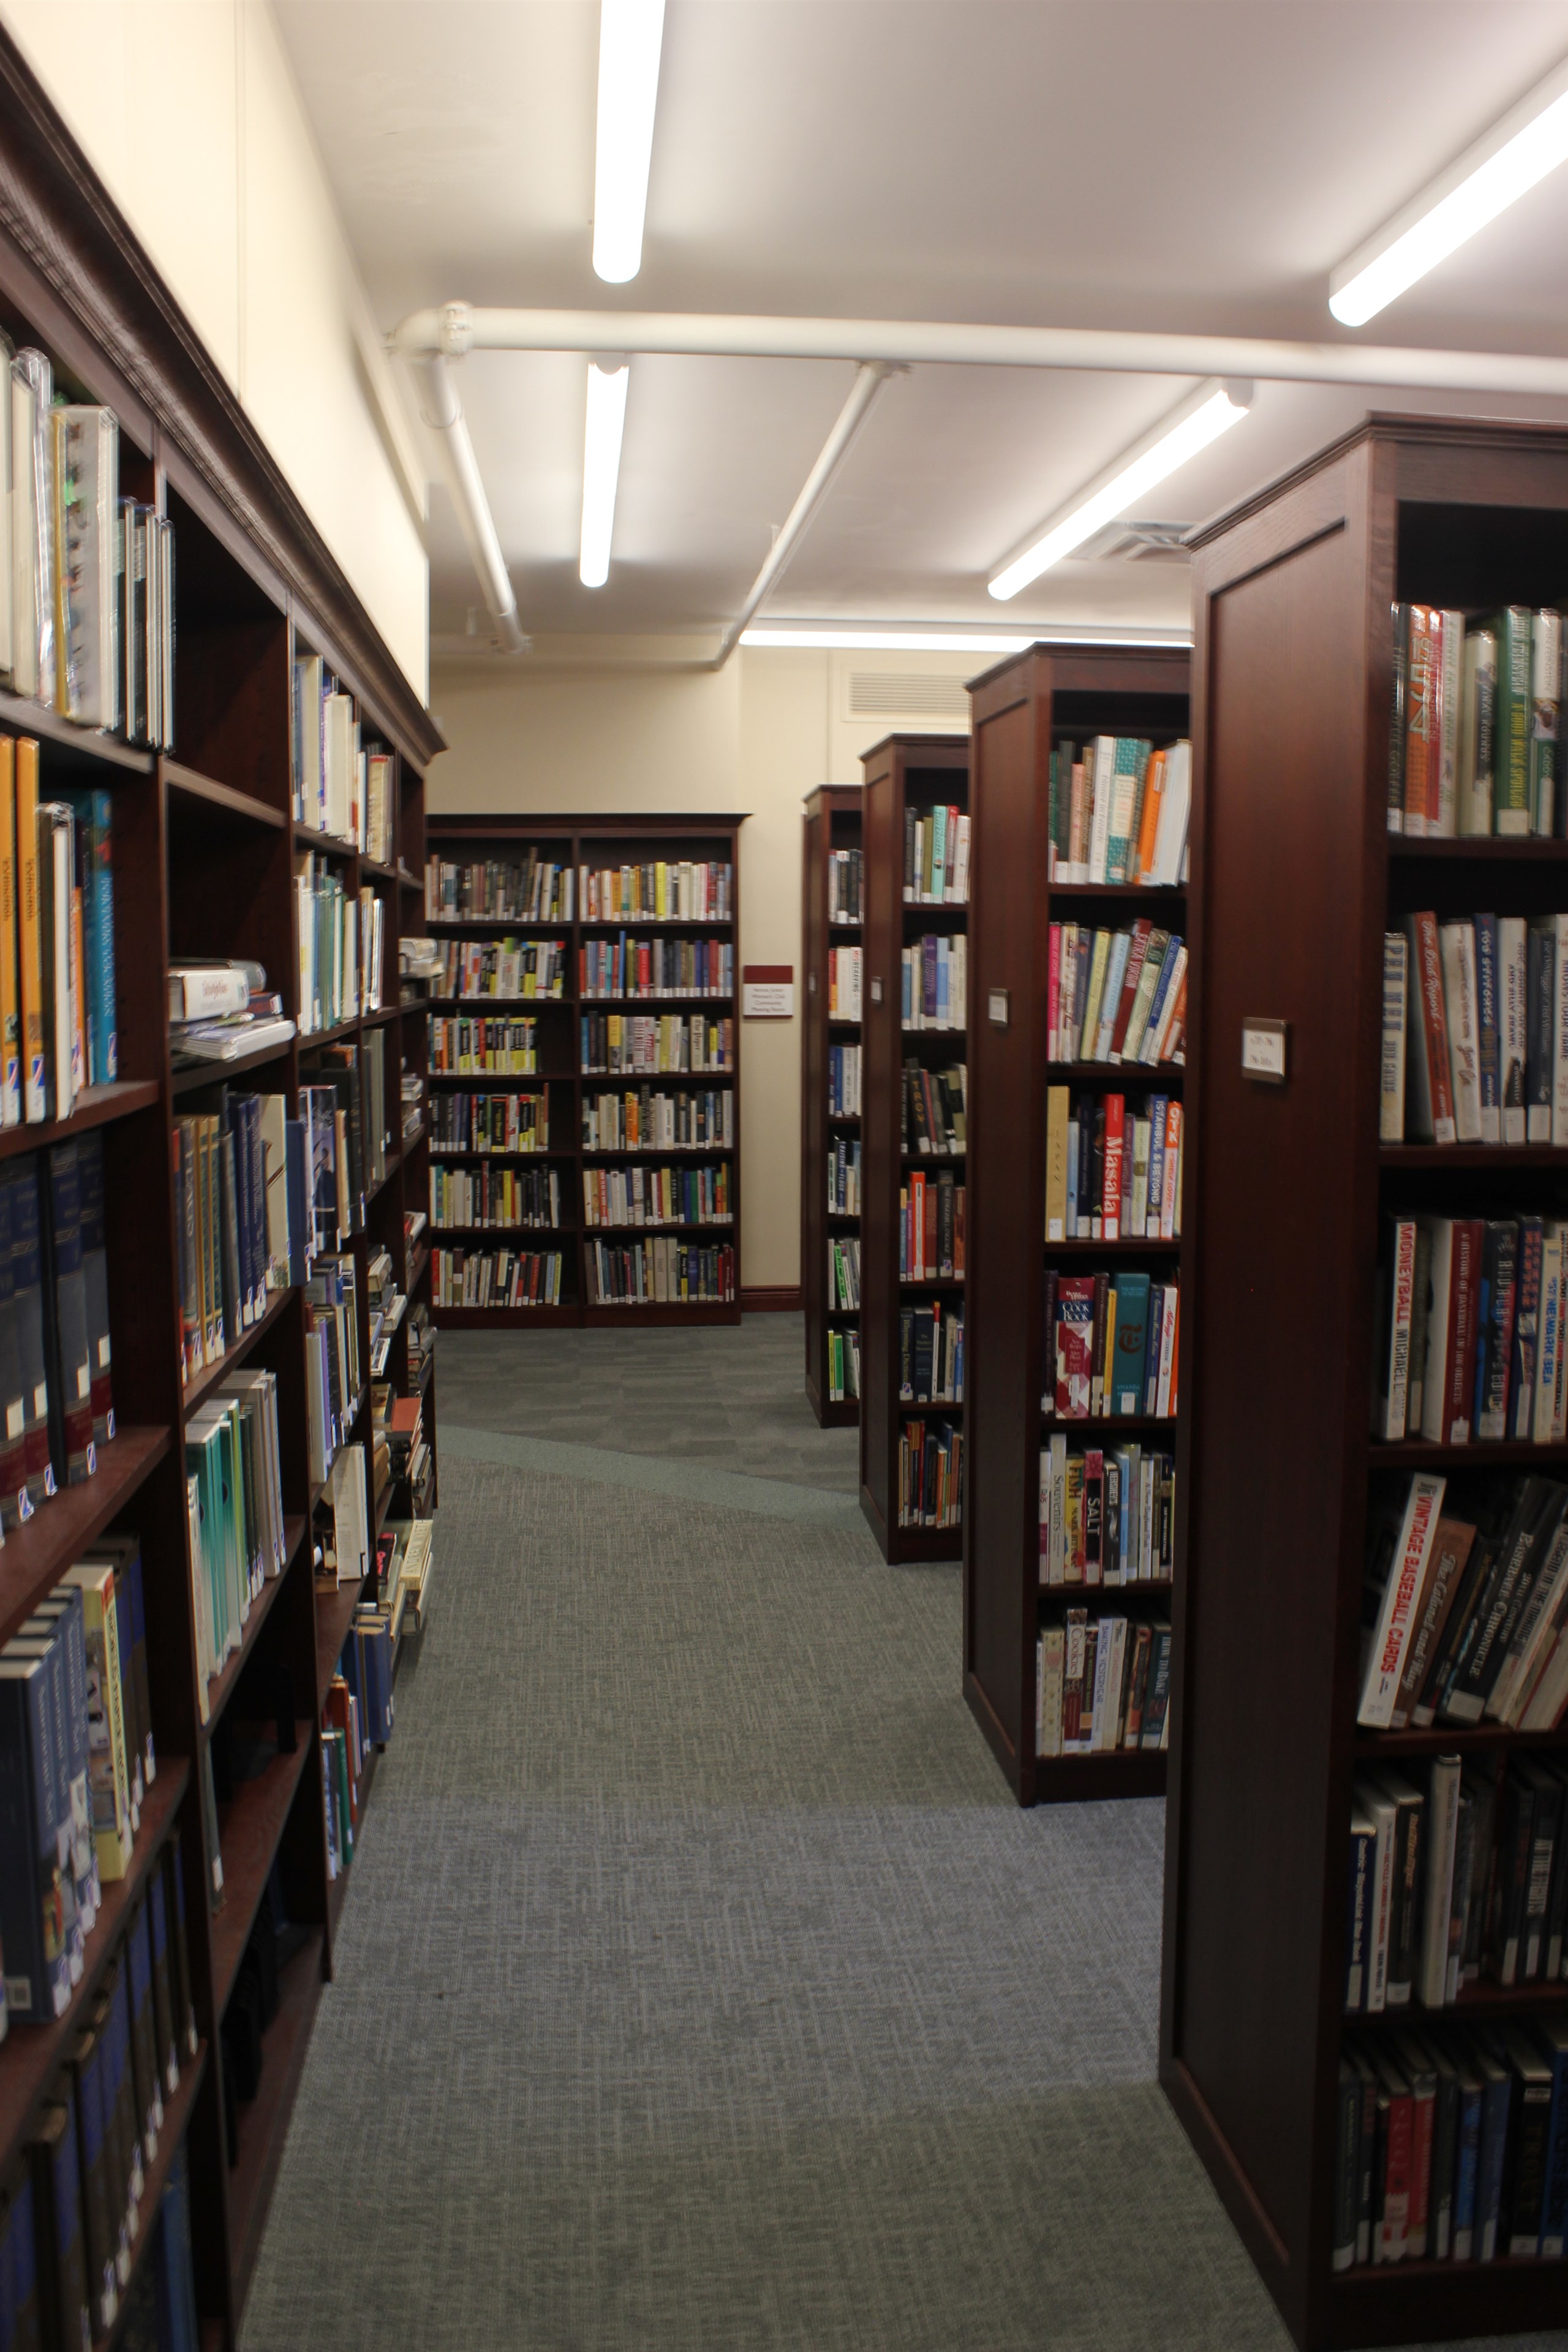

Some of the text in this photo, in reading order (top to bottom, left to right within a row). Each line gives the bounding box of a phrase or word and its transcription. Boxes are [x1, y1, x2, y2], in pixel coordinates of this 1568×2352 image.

[1430, 643, 1441, 668] MEN
[1511, 616, 1528, 695] JOHN FEINSTEIN
[1543, 646, 1556, 692] FEINSTEIN
[1480, 685, 1493, 762] FINAL ROUNDS
[1510, 712, 1525, 734] GOOD
[1510, 739, 1524, 764] WALK
[1389, 750, 1402, 807] GOLFER
[1509, 767, 1524, 807] SPOILED
[2, 859, 12, 922] Extinction
[24, 860, 36, 922] Extinction
[1421, 920, 1434, 944] The
[852, 950, 861, 992] MISBEHAVING
[1125, 932, 1148, 989] EXTRA VIRGIN
[1423, 947, 1438, 976] Dad
[1507, 964, 1517, 982] AND
[1382, 944, 1403, 1033] PEN MEN
[1424, 977, 1442, 1020] Report
[1507, 987, 1517, 1011] BILLY
[633, 1022, 644, 1052] DEFENDER
[693, 1032, 702, 1050] Paper
[1512, 1065, 1521, 1102] DONNELLY
[1150, 1100, 1164, 1204] ISTANBUL & BEYOND
[1104, 1136, 1123, 1214] Masala
[1396, 1225, 1414, 1324] MONEYBALL
[1460, 1241, 1470, 1278] HISTORY
[1522, 1231, 1533, 1308] MANTLE
[1494, 1260, 1515, 1327] RIVALRY
[901, 1319, 911, 1351] Rhyming
[1456, 1294, 1468, 1338] BASEBALL
[1544, 1297, 1558, 1355] NEWARK
[1393, 1329, 1408, 1379] MICHAEL
[1455, 1351, 1464, 1363] 100
[1453, 1367, 1463, 1404] OBJECTS
[1053, 1475, 1064, 1531] Souvenirs
[1068, 1466, 1082, 1499] FISH
[1087, 1497, 1101, 1536] SALT
[1381, 1495, 1434, 1674] VINTAGE BASEBALL CARDS
[1438, 1551, 1457, 1578] The
[1422, 1581, 1448, 1632] Colonel
[1069, 1627, 1082, 1676] Cookies
[1161, 1636, 1171, 1657] HOW
[1469, 1602, 1508, 1678] CHRONICLE
[1096, 1626, 1109, 1703] BAKING YESTERYEAR
[1155, 1671, 1169, 1695] BAKE
